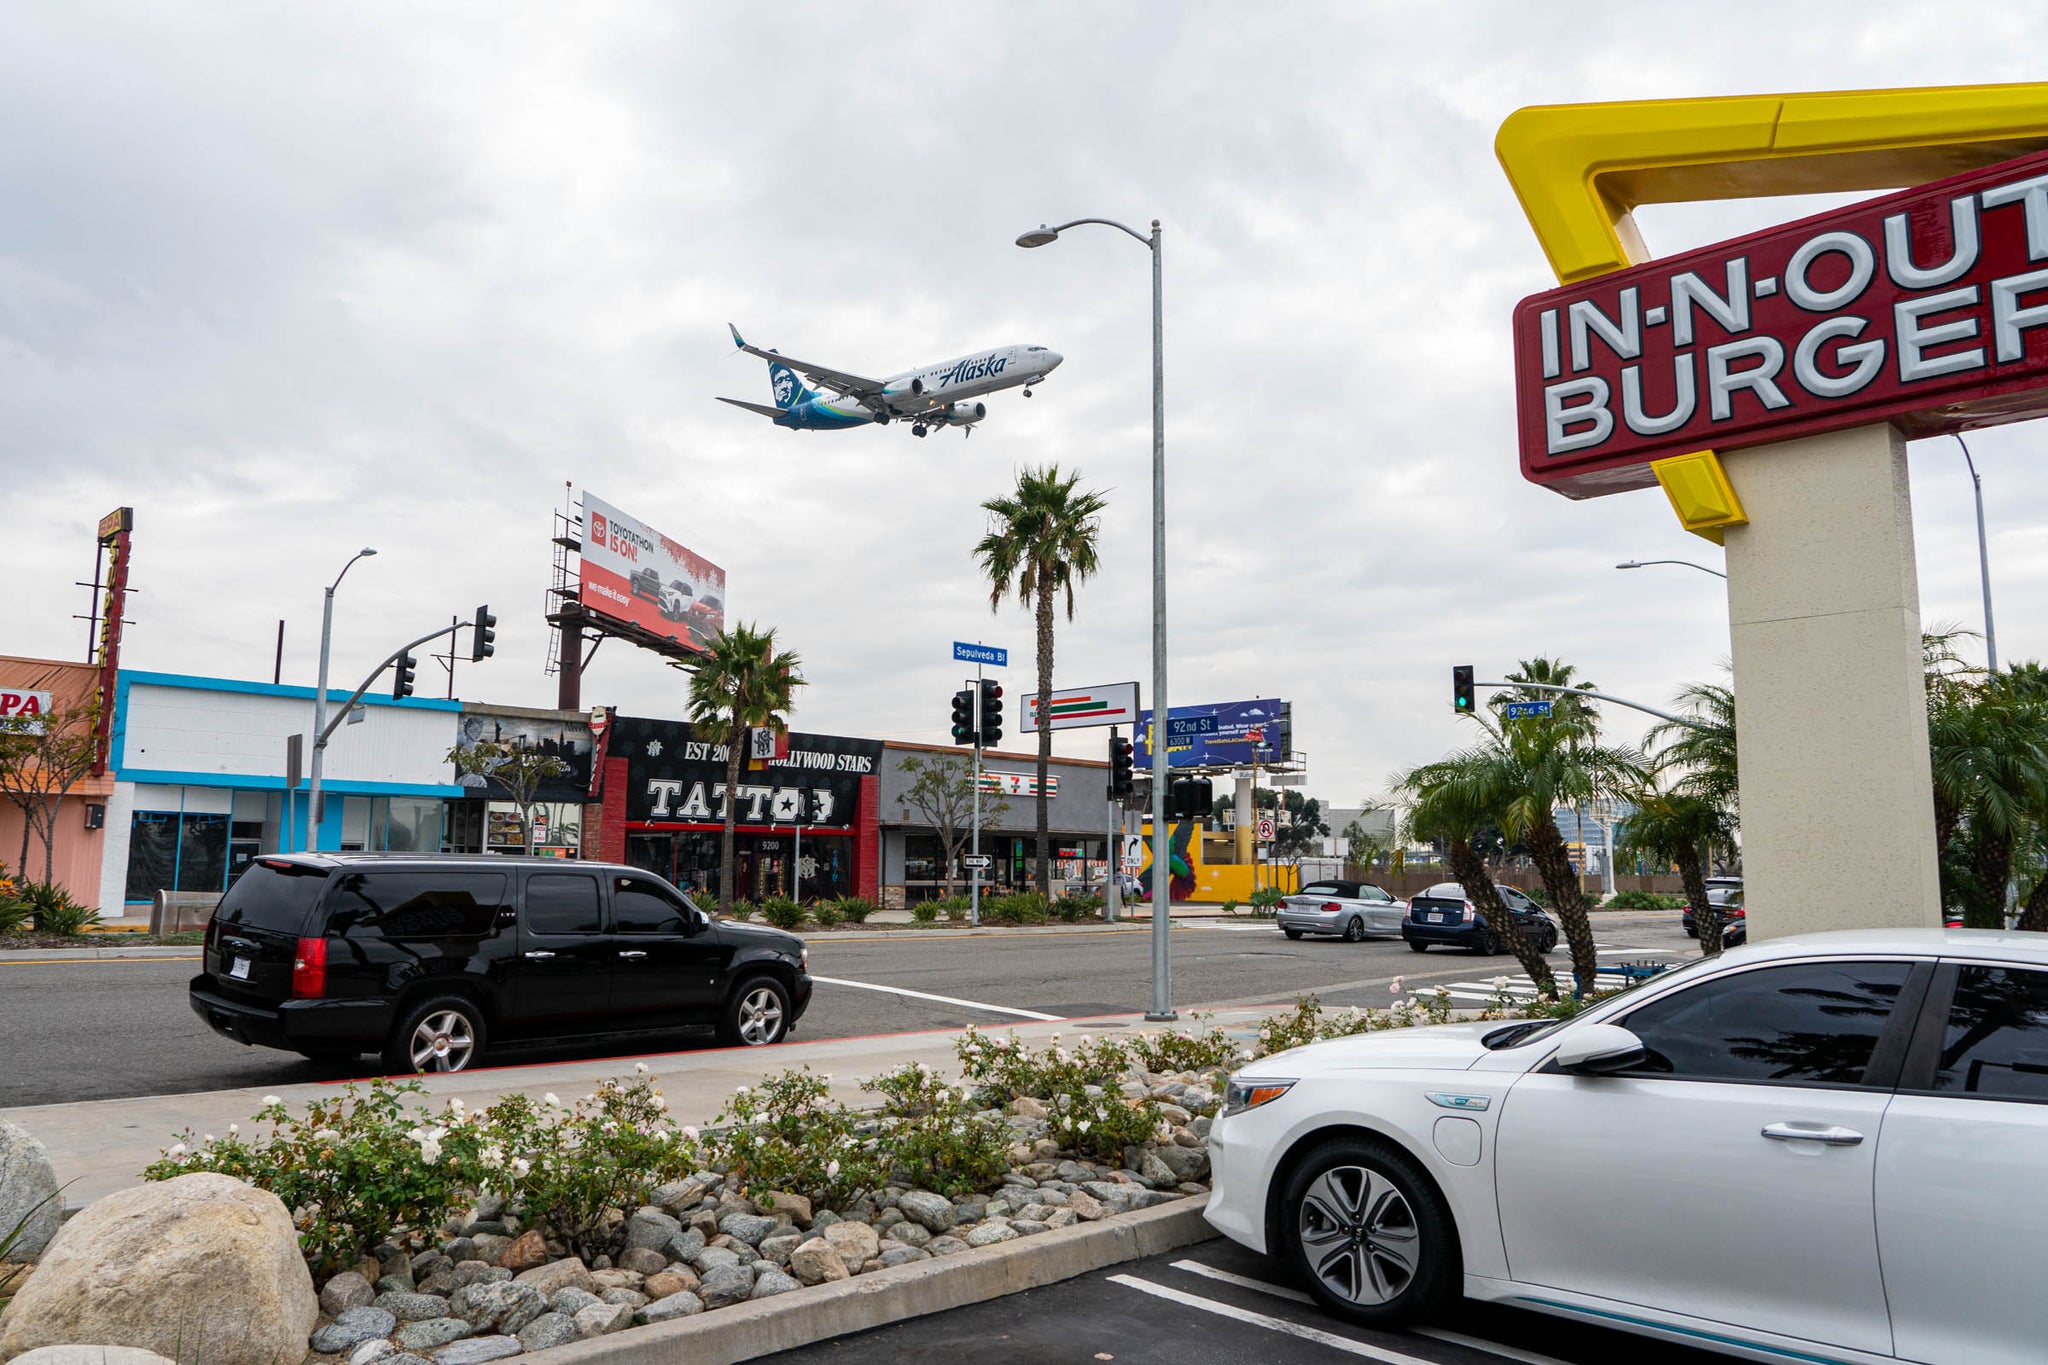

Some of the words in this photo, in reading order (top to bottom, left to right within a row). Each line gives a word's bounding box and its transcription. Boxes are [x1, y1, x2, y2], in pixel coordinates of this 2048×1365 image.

[1540, 172, 2048, 380] IN-N-OUT
[939, 354, 1007, 388] Alaska
[100, 512, 120, 536] SPA
[609, 520, 654, 553] TOYOTATHON
[610, 534, 619, 553] IS
[620, 539, 638, 563] ON!
[588, 581, 598, 592] we
[597, 585, 613, 598] make
[616, 593, 630, 607] easy
[956, 646, 995, 661] Sepulveda
[1173, 720, 1197, 733] 92nd
[1200, 718, 1211, 730] St
[684, 741, 711, 760] EST
[711, 744, 731, 762] 200
[1169, 736, 1185, 746] 6300
[1185, 736, 1191, 745] W
[836, 754, 872, 773] STARS
[647, 778, 835, 823] TATTOO
[762, 841, 779, 850] 9200
